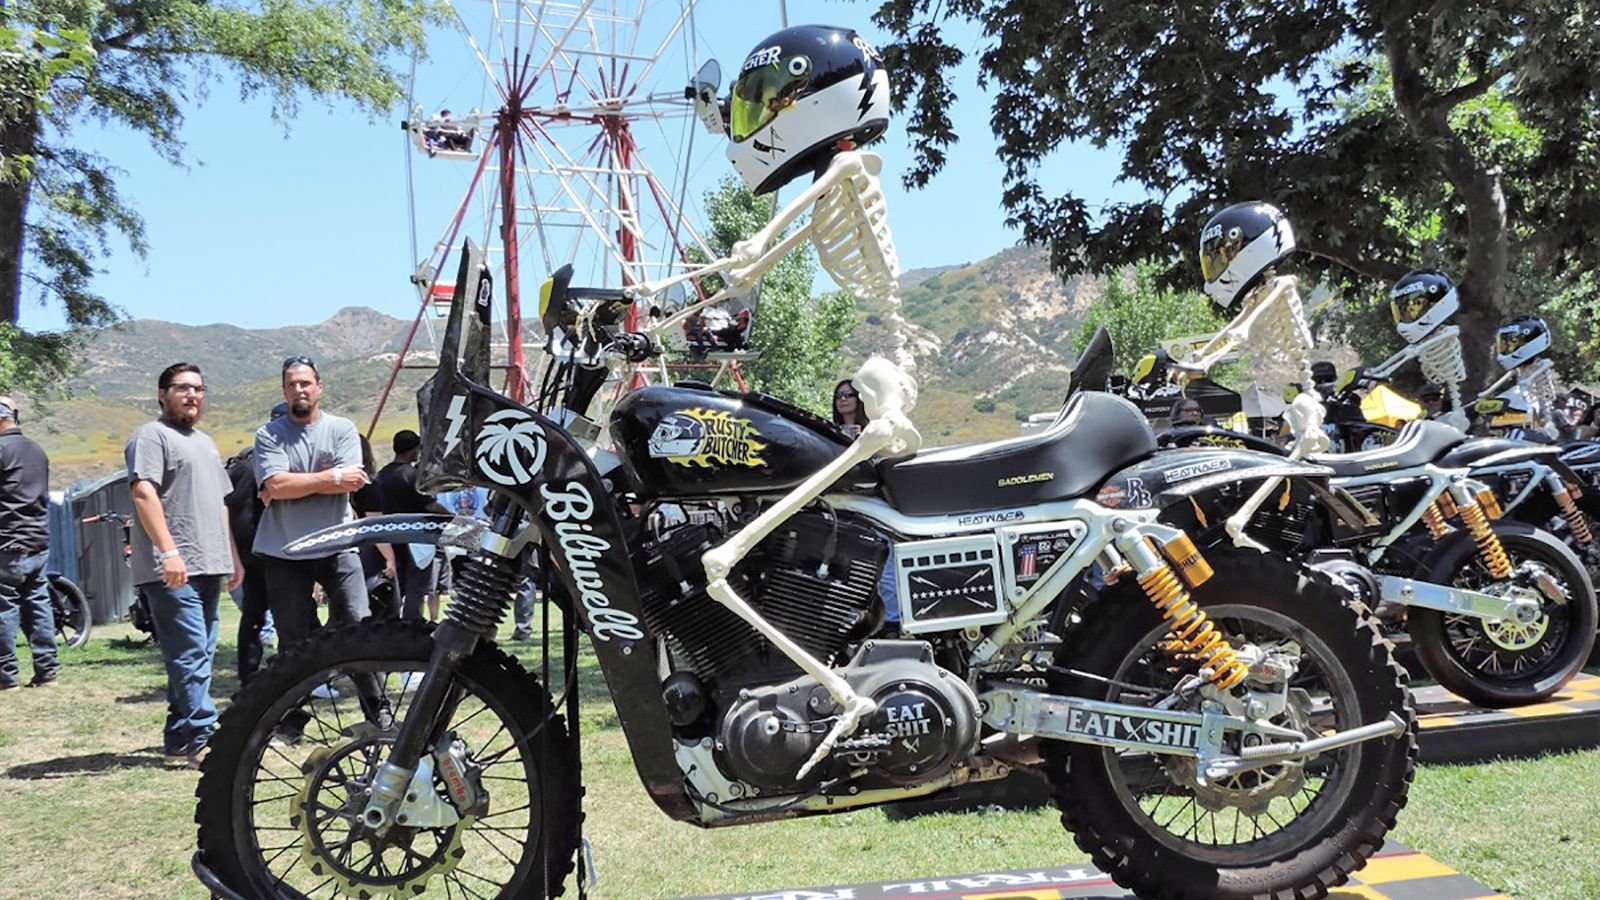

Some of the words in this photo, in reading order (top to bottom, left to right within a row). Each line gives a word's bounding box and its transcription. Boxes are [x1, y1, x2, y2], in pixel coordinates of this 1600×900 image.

[704, 418, 745, 440] RUSTY
[702, 436, 750, 461] BUTCHER
[540, 481, 644, 641] Biltwell
[887, 702, 925, 722] EAT
[886, 718, 931, 738] SHIT
[1069, 709, 1121, 738] EAT
[1146, 721, 1201, 748] SHIT
[882, 868, 1108, 893] TRAIL
